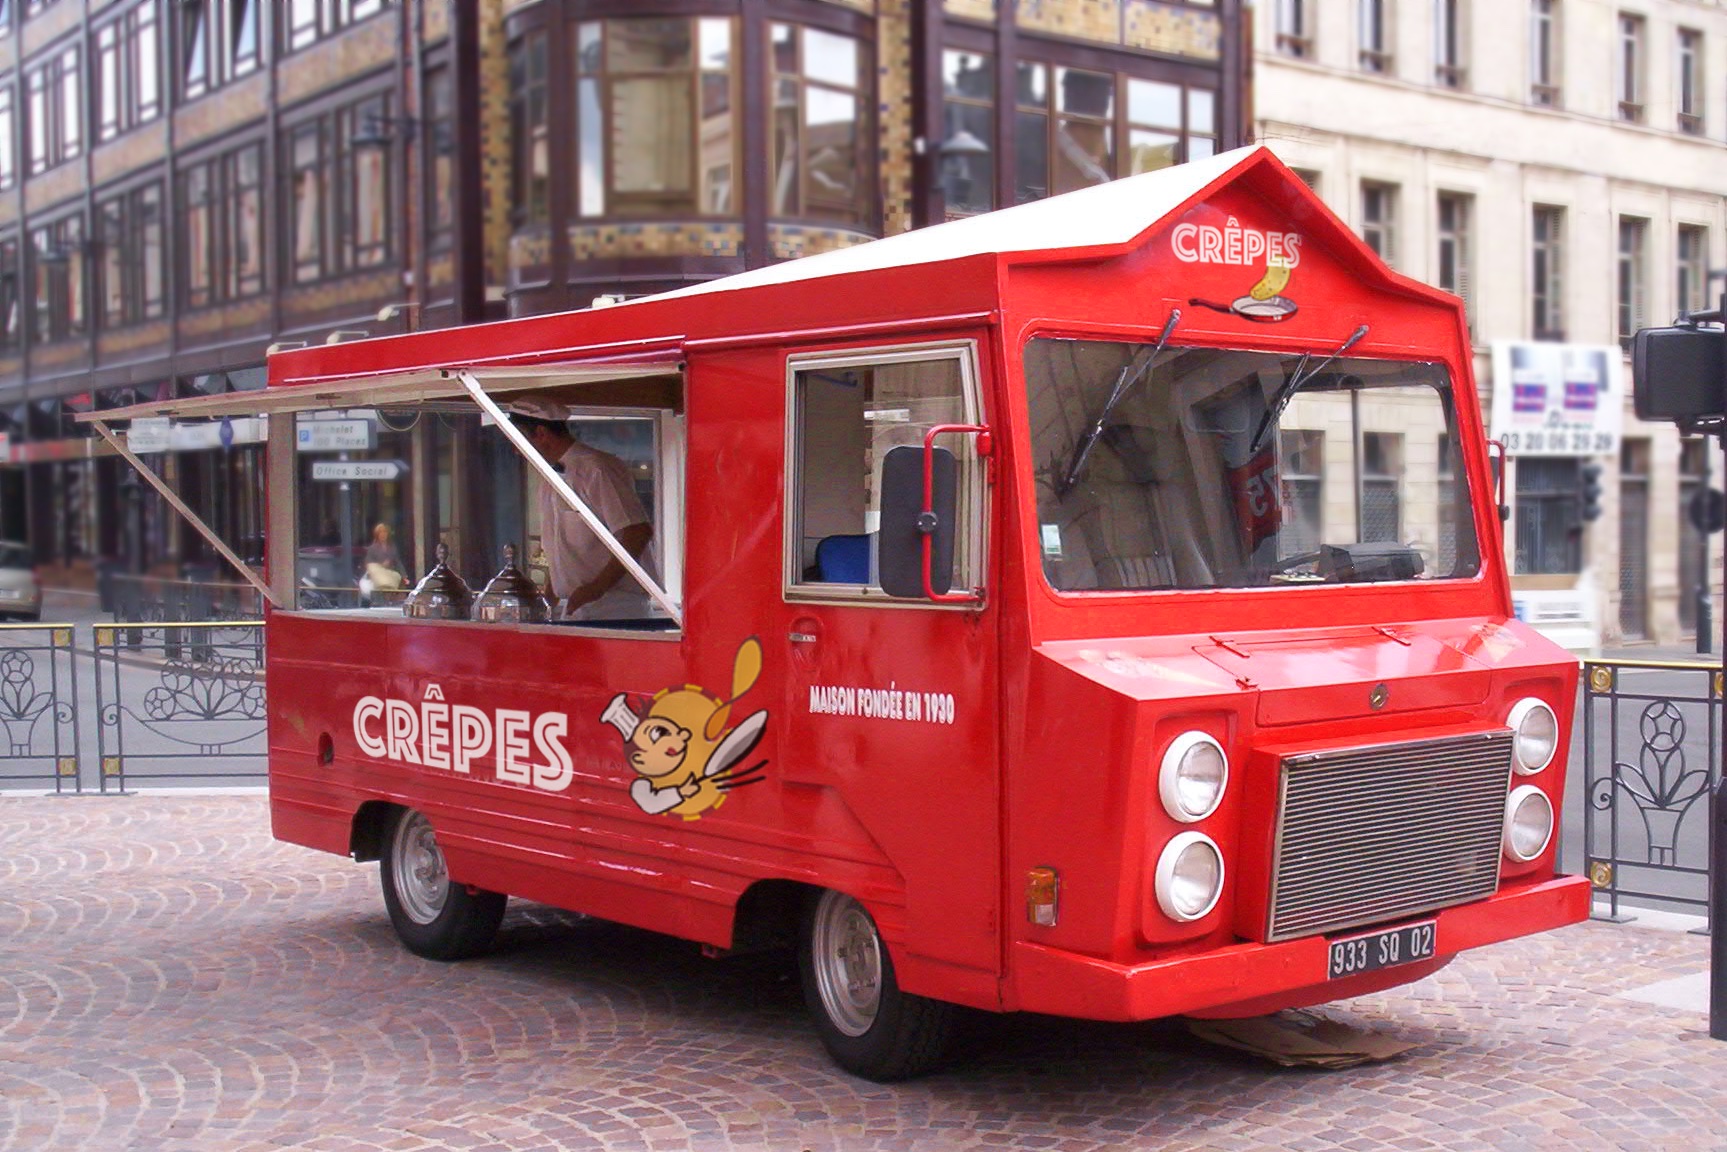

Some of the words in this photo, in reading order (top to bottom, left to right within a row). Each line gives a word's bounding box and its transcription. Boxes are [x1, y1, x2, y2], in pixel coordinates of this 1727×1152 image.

[1171, 215, 1302, 269] CRÊPES
[336, 437, 366, 446] Places
[1501, 433, 1519, 450] 03
[316, 466, 347, 476] Office
[355, 466, 387, 476] Social
[809, 685, 855, 716] MAISON
[857, 681, 903, 720] FONDÉE
[905, 692, 921, 721] EN
[924, 693, 955, 725] 1930
[353, 684, 573, 791] CRÊPES
[1333, 940, 1367, 974] 933
[1379, 933, 1400, 964] SQ
[1411, 926, 1432, 957] 02
